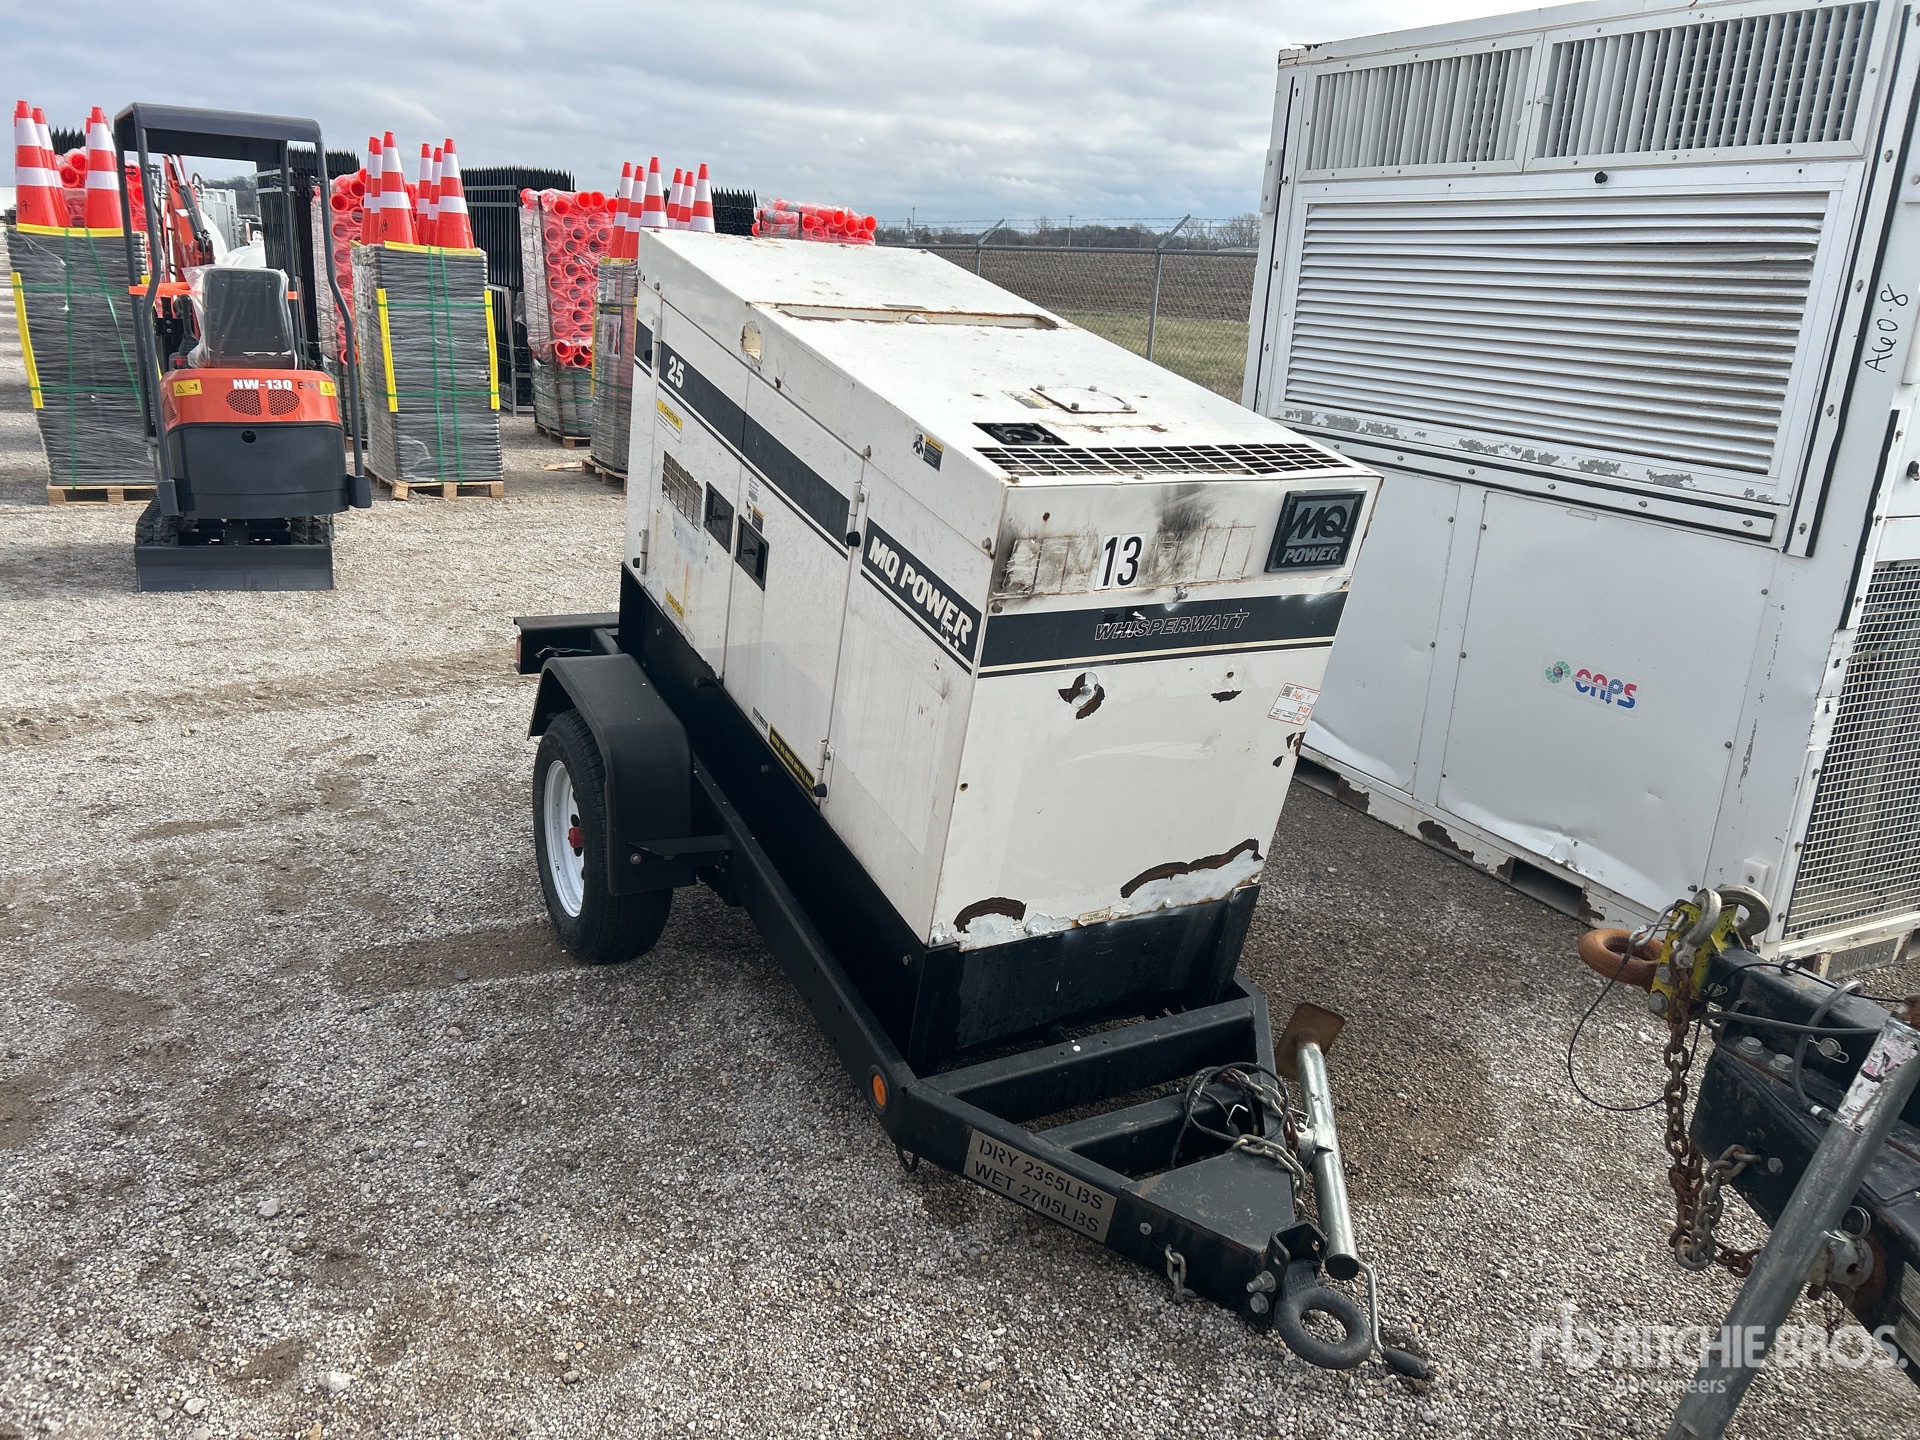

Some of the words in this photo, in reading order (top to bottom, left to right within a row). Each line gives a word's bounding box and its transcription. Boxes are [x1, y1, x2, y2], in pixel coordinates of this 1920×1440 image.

[232, 379, 293, 390] NW-13Q
[667, 355, 685, 389] 25
[1284, 504, 1348, 540] MQ
[1102, 536, 1143, 587] 13
[1280, 545, 1341, 564] POWER
[868, 535, 900, 585] MQ
[899, 562, 973, 646] POWER
[1094, 611, 1250, 641] WHISPERWATT
[979, 1139, 1020, 1168] DRY
[1022, 1160, 1104, 1210] 2365LBS
[975, 1159, 1016, 1191] WET
[1018, 1183, 1100, 1233] 2705LBS
